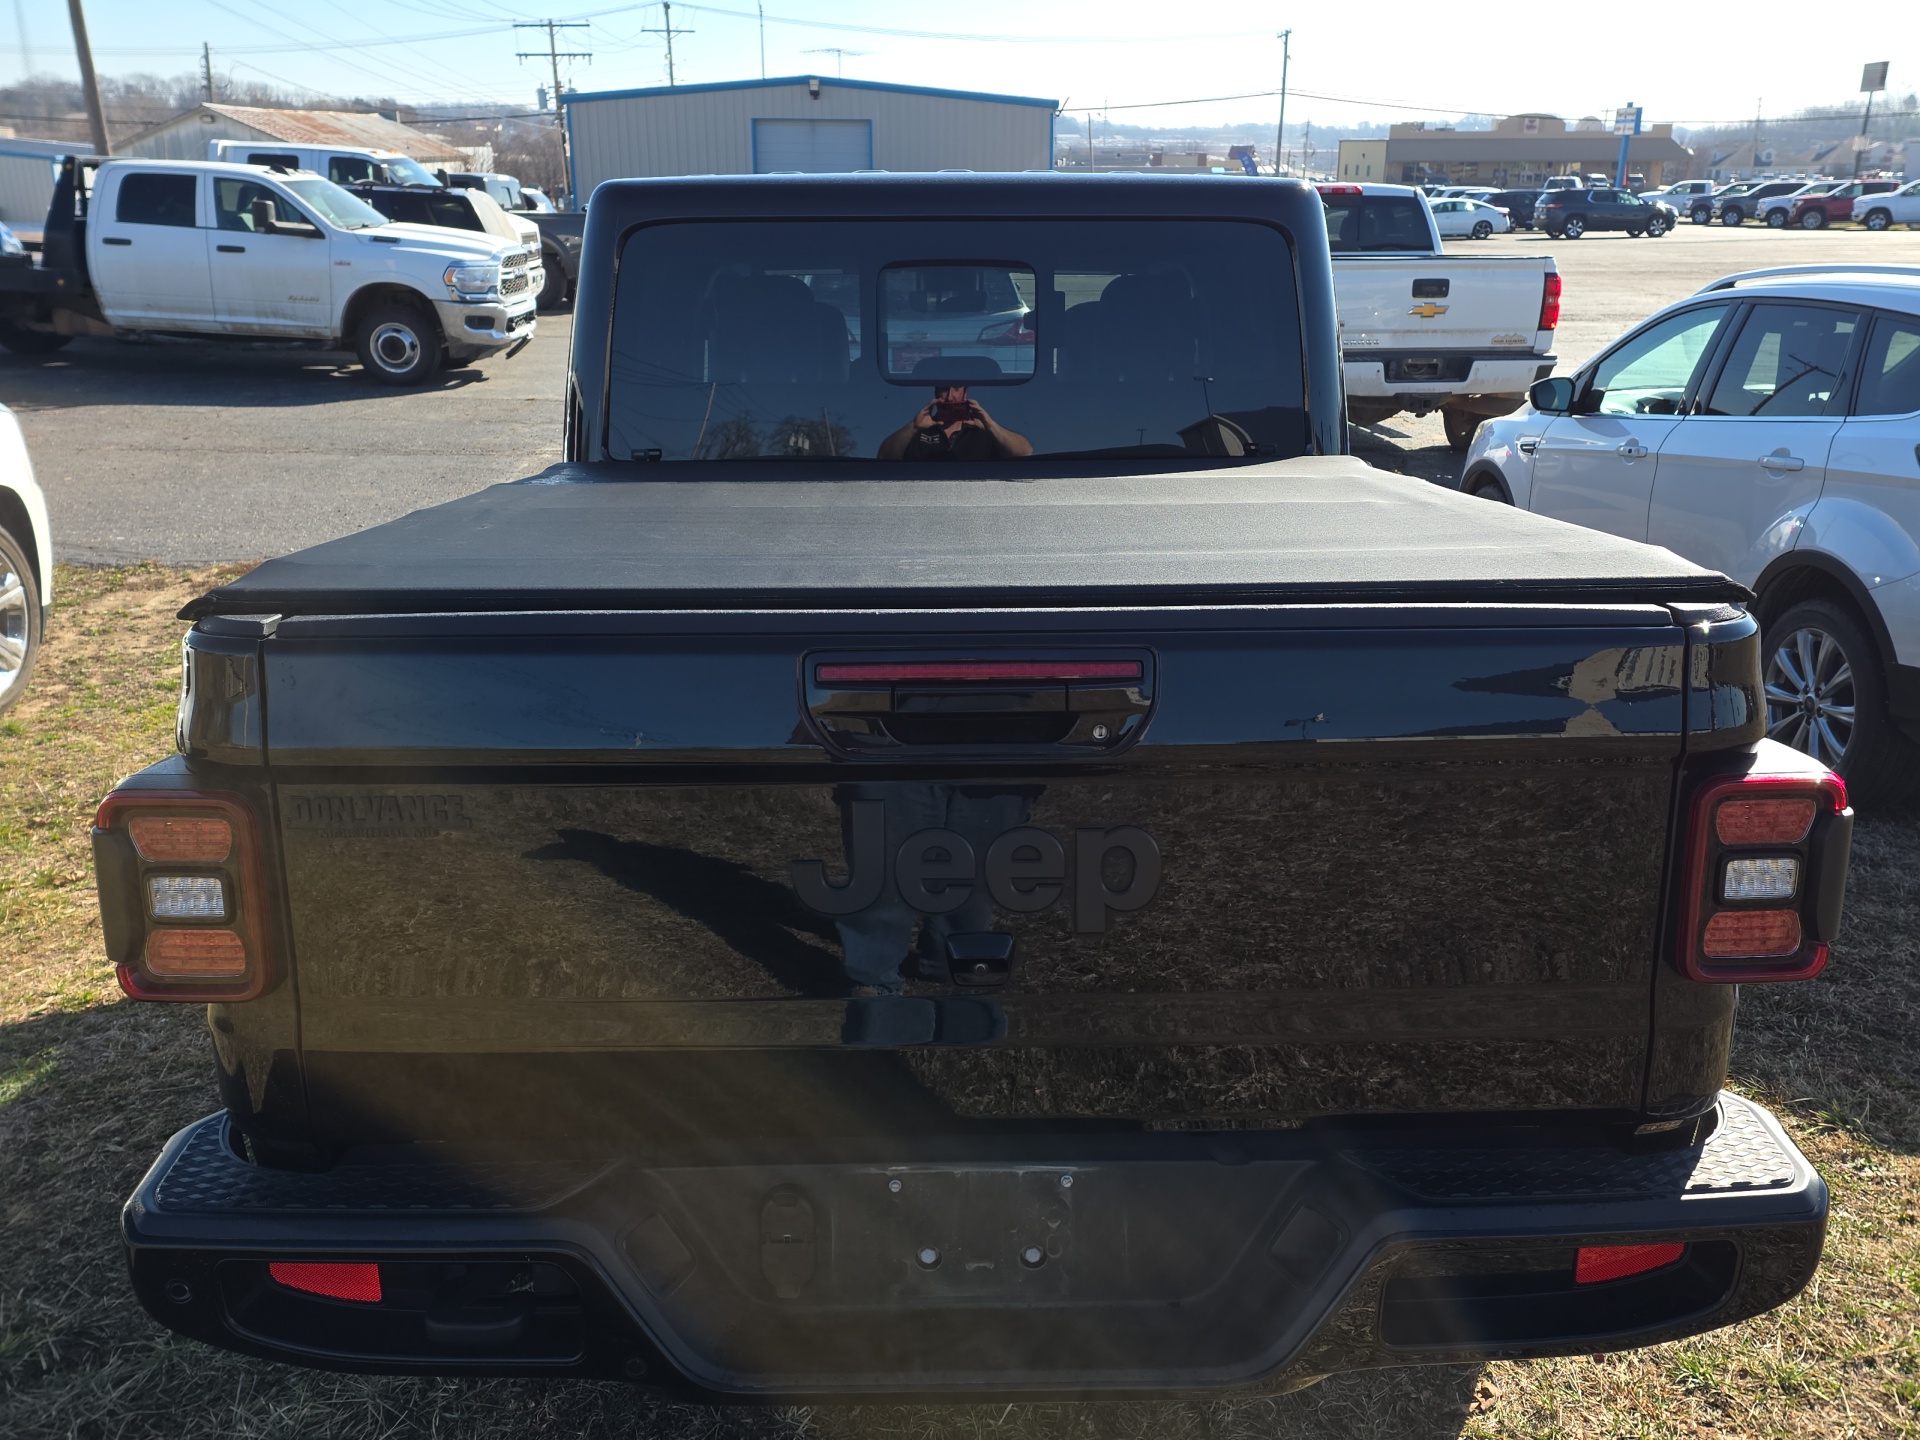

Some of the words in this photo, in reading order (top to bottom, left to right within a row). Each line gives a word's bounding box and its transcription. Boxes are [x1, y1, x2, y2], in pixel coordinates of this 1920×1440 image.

[289, 795, 353, 824] DON
[360, 795, 466, 824] VANCE
[791, 799, 1162, 934] Jeep
